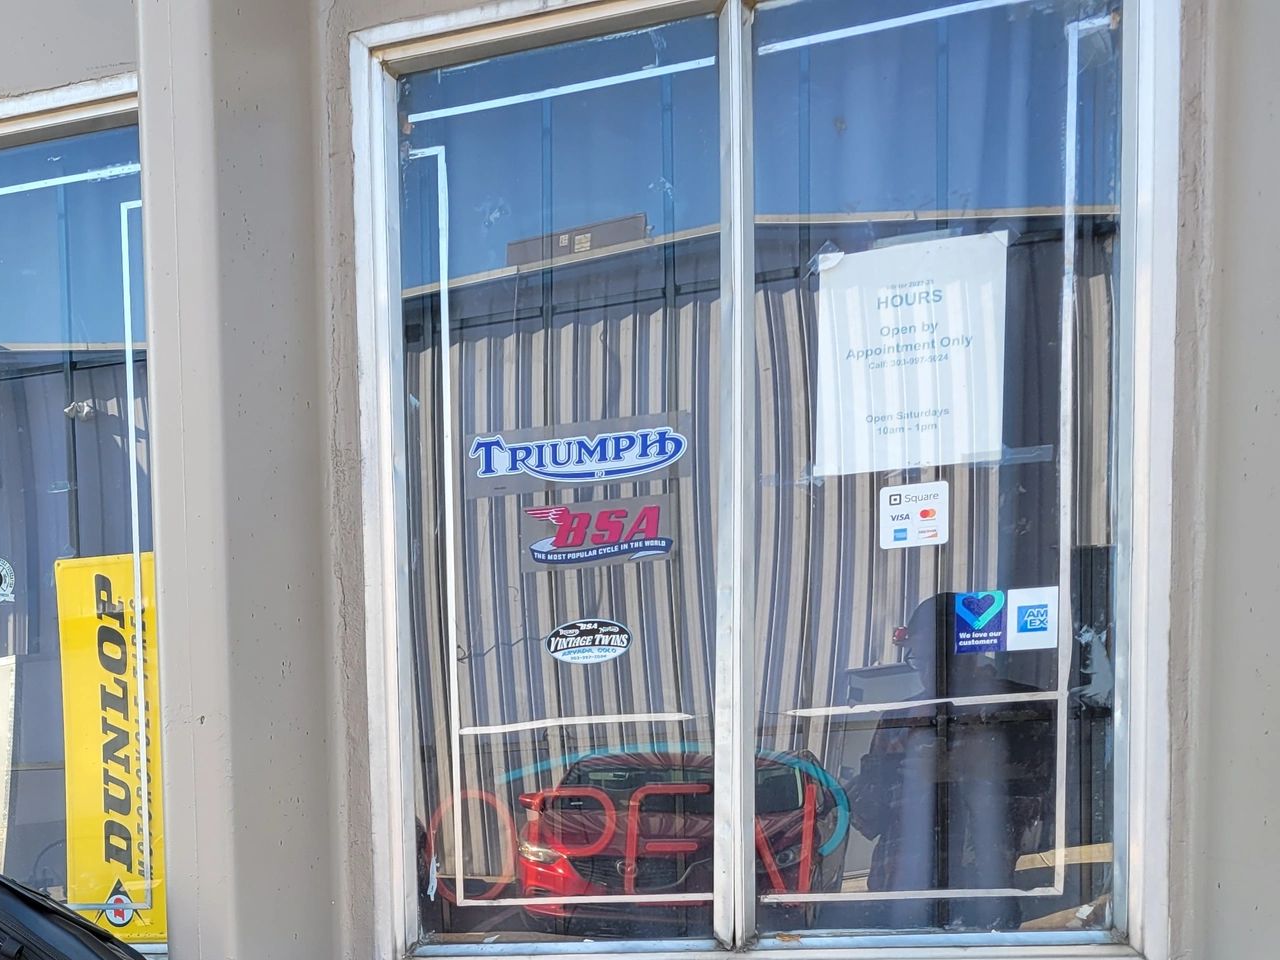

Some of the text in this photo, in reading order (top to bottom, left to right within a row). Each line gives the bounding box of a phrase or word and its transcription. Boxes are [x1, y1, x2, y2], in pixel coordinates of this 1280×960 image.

[877, 289, 943, 310] HOURS
[880, 321, 938, 338] Open by
[846, 335, 973, 360] Appointment Only
[865, 408, 950, 424] Open Saturdays
[878, 426, 904, 435] 10am
[915, 423, 937, 432] 1pm
[470, 428, 687, 481] TRIUMPH
[904, 493, 939, 503] Square
[544, 505, 660, 548] BSA
[890, 513, 910, 521] VISA
[534, 552, 546, 560] THE
[547, 551, 566, 560] MOST
[567, 549, 597, 560] POPULAR
[598, 545, 619, 554] CYCLE
[629, 541, 642, 549] THE
[645, 539, 666, 547] WORLD
[550, 634, 628, 652] VINTAGE TWINS
[95, 574, 133, 873] DUNLOP
